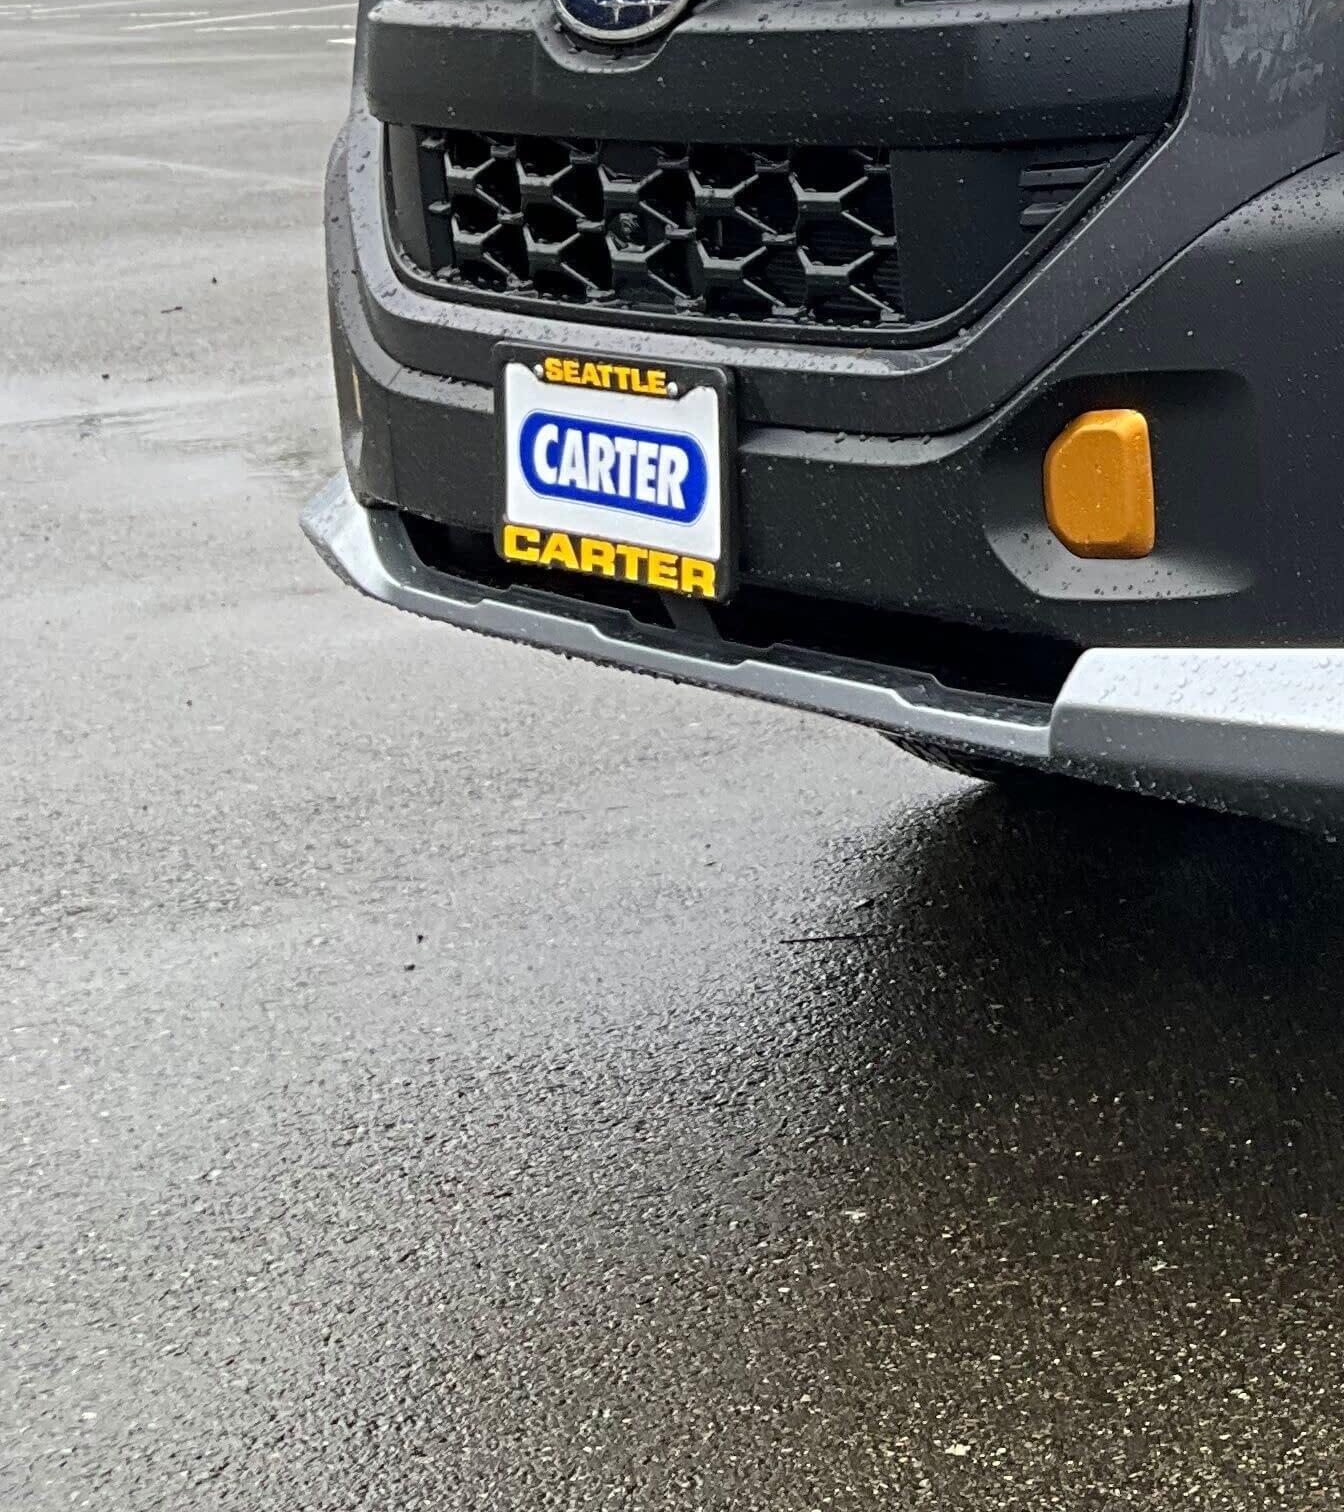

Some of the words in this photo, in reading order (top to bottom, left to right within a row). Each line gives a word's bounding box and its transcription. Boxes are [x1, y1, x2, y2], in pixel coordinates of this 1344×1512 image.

[544, 357, 668, 396] SEATTLE
[533, 423, 690, 511] CARTER
[503, 524, 716, 598] CARTER
